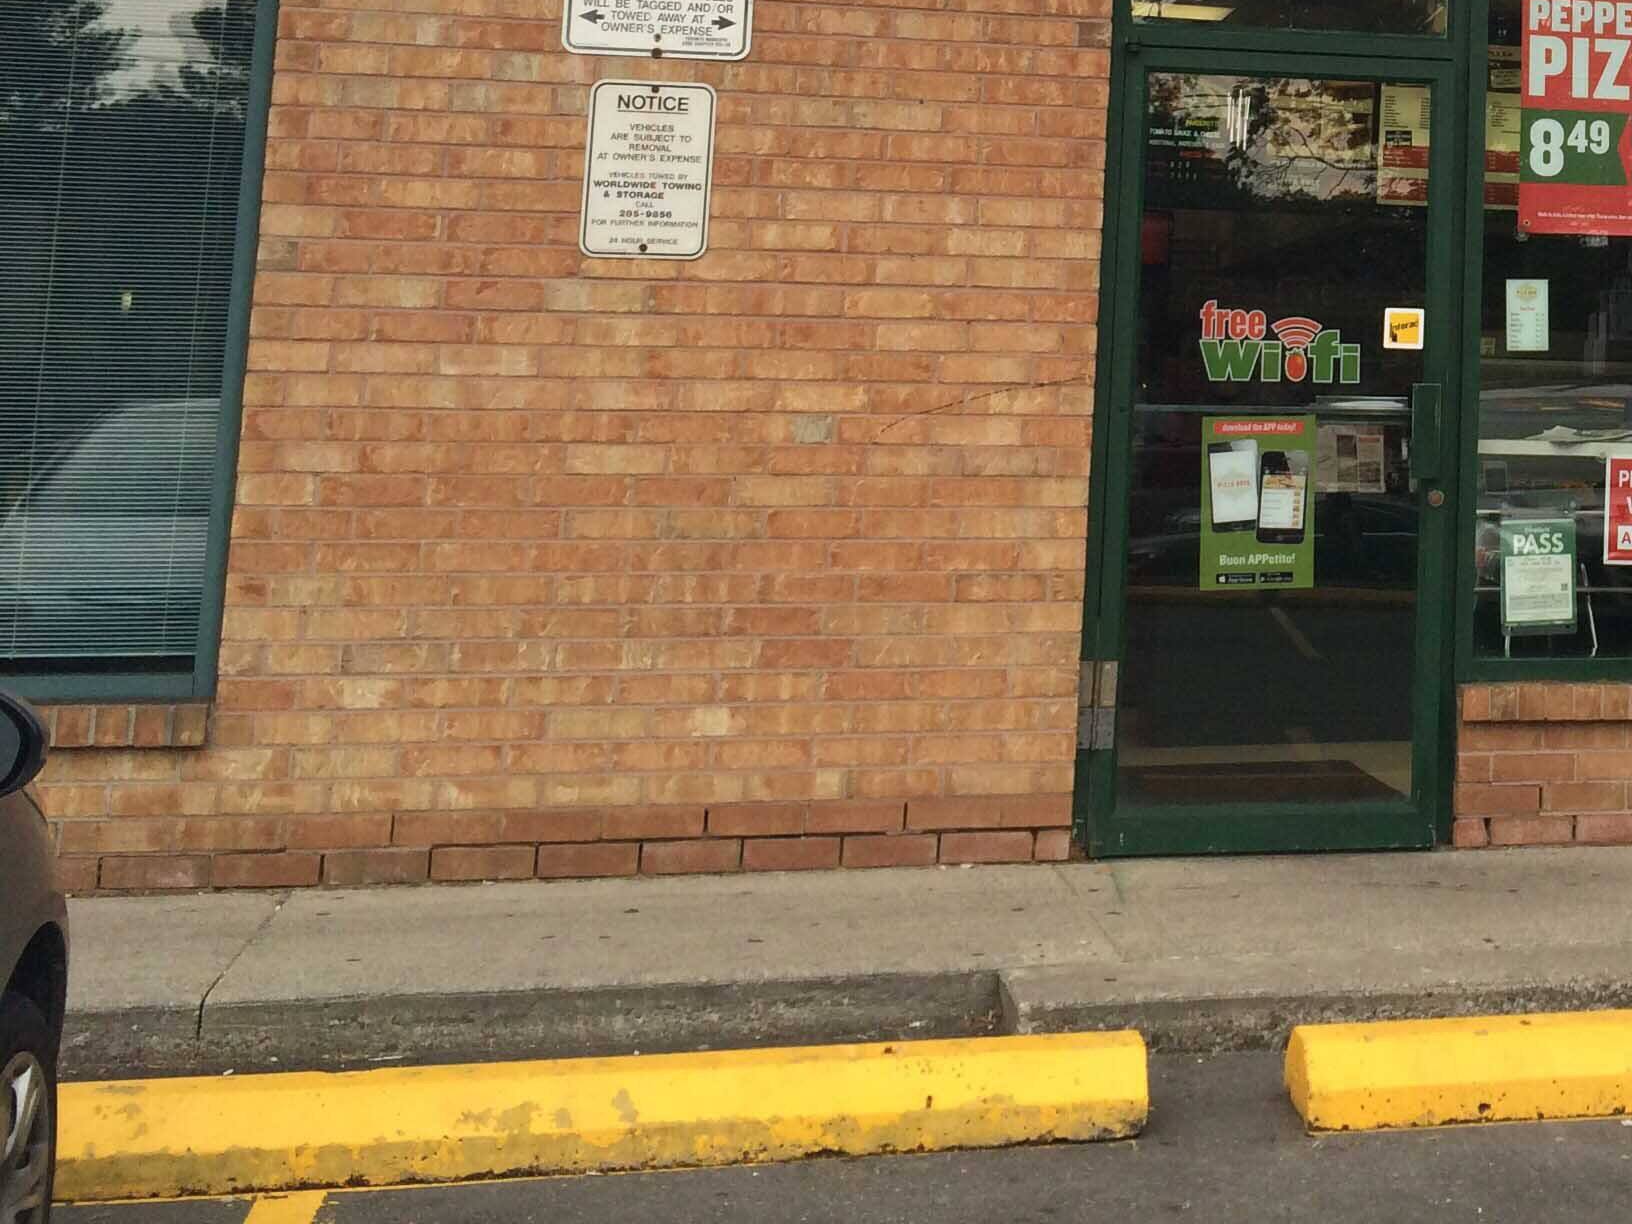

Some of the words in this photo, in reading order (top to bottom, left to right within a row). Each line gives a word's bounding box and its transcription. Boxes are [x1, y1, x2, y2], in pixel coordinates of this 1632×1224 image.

[616, 0, 630, 8] BE
[637, 0, 682, 11] TAGGED
[611, 10, 651, 21] TOWED
[658, 13, 687, 23] AWAY
[692, 14, 705, 24] AT
[601, 22, 655, 34] OWNER'S
[661, 24, 713, 36] EXPENSE
[617, 95, 689, 112] NOTICE
[630, 124, 674, 132] VEHICLES
[633, 134, 675, 142] SUBJECT
[680, 135, 692, 143] TO
[629, 144, 672, 152] REMOVAL
[613, 154, 656, 162] OWNER'S
[660, 155, 702, 163] EXPENSE
[593, 180, 656, 189] WORLDWIDE
[662, 182, 702, 191] TOWING
[617, 191, 664, 199] STORAGE
[1200, 299, 1267, 340] free
[1512, 533, 1564, 555] PASS
[1219, 554, 1245, 565] Buon
